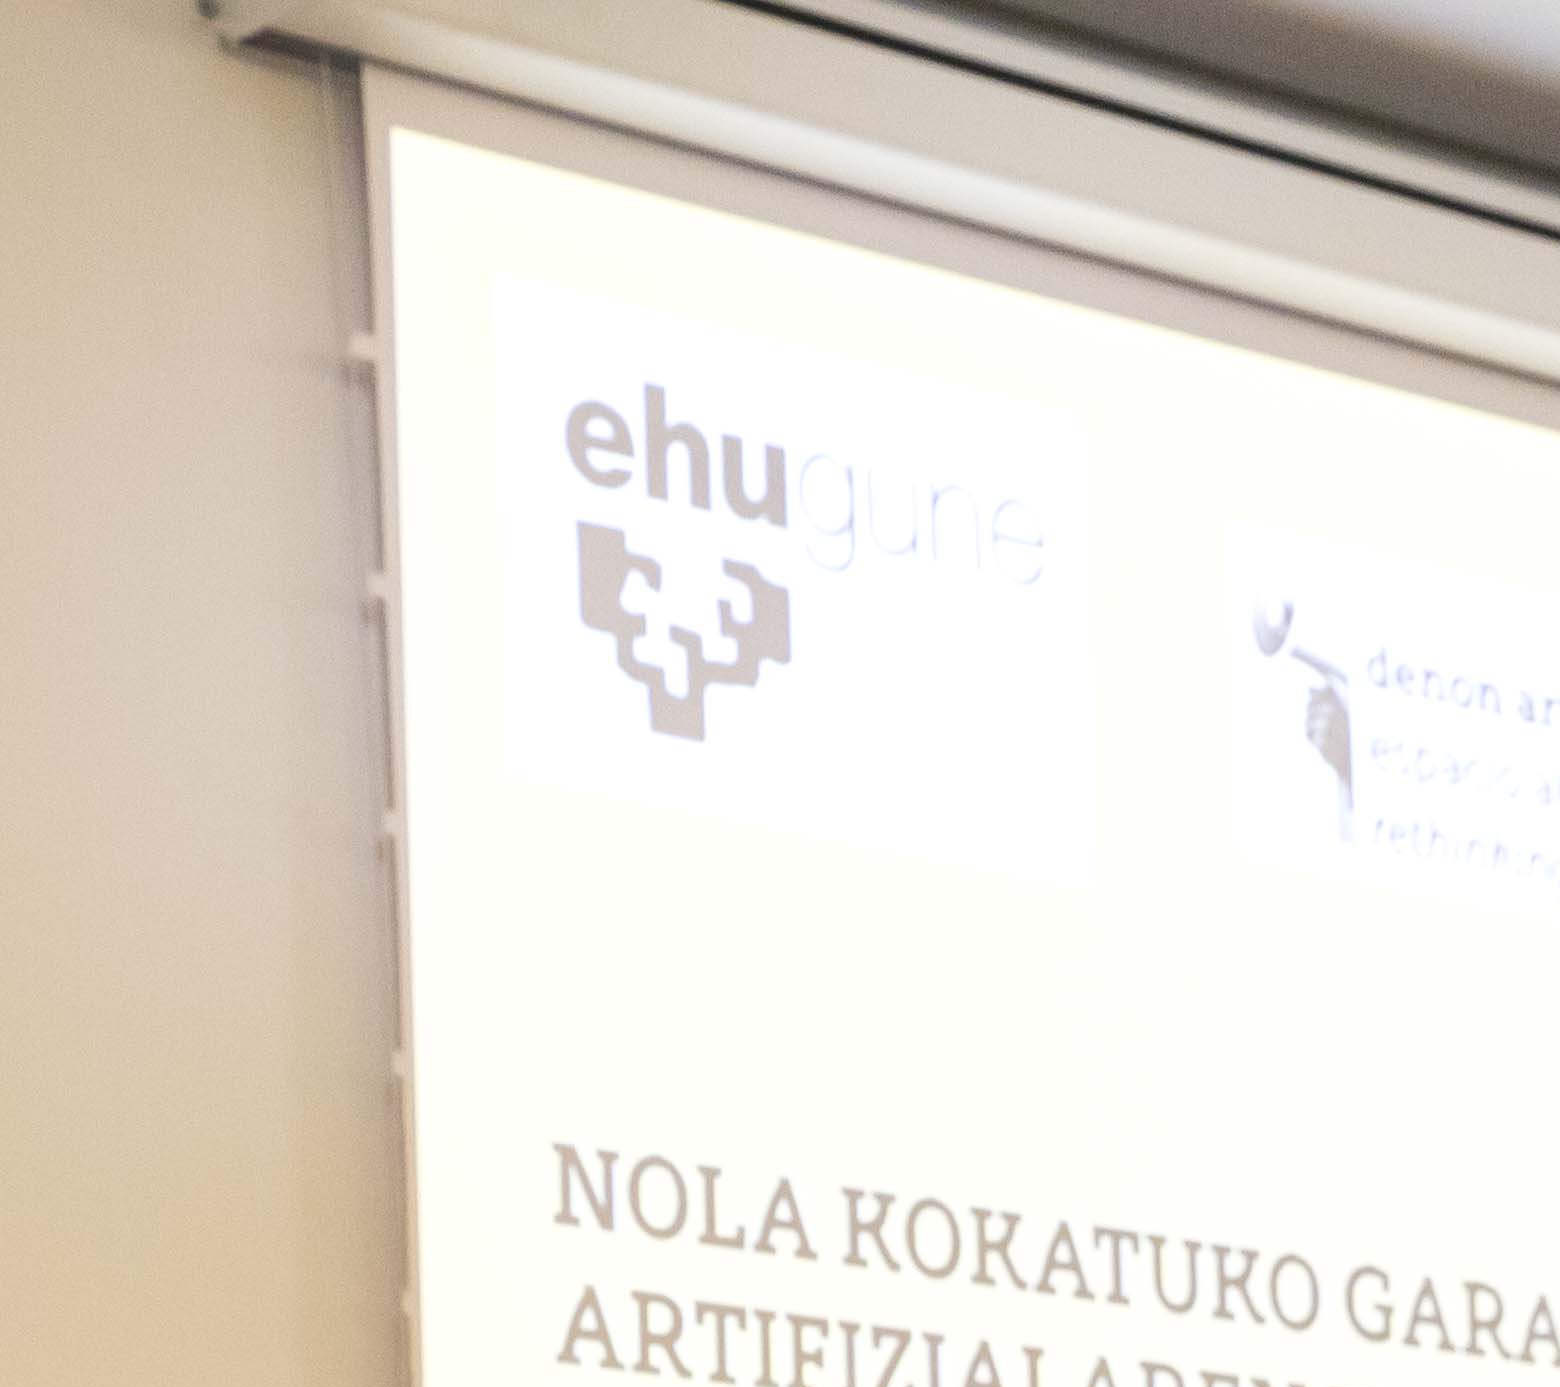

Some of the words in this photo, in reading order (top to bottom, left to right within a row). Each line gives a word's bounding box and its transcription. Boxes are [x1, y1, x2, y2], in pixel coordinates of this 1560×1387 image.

[1366, 648, 1502, 714] denon
[549, 1139, 821, 1264] NOLA
[839, 1184, 1322, 1335] KOKATUKO
